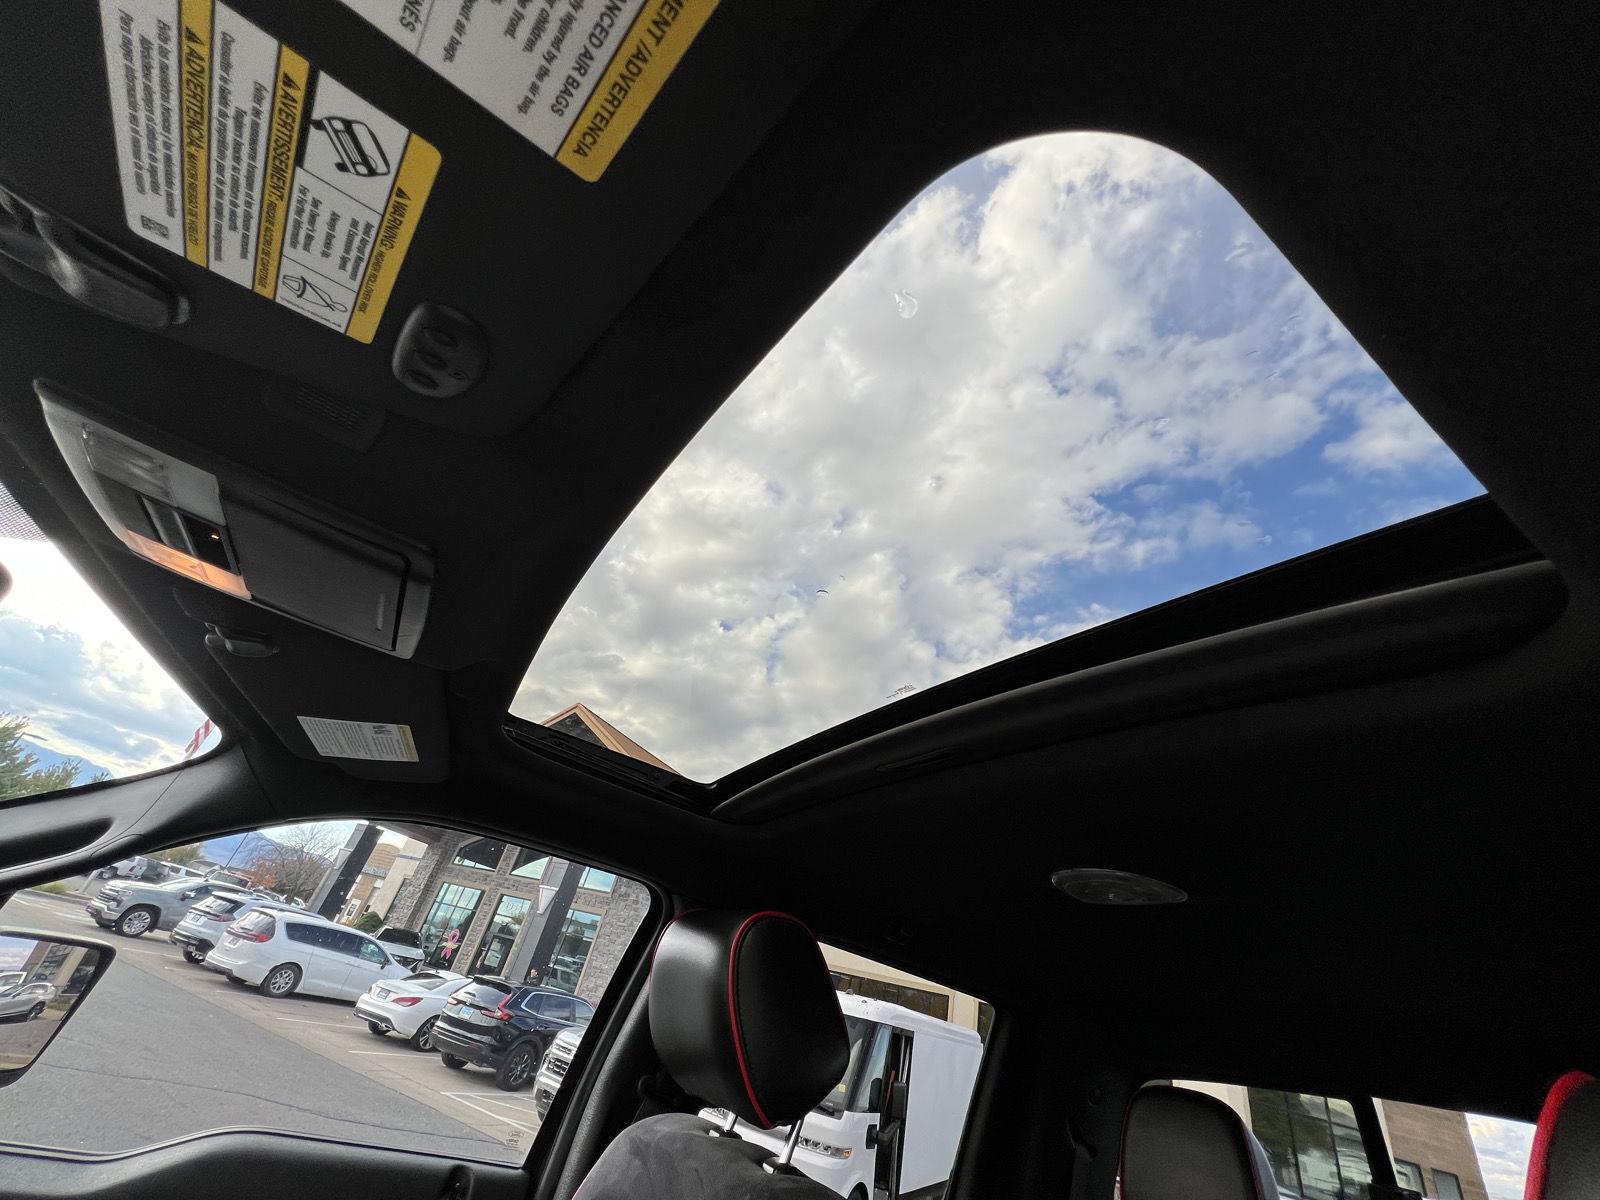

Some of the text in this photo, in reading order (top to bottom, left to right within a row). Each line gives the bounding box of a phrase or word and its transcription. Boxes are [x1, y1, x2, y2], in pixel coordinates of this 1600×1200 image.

[454, 19, 466, 37] air
[551, 12, 576, 53] injured
[543, 49, 558, 65] by
[551, 0, 627, 117] NCED AIR BAGS
[535, 64, 550, 82] the
[529, 81, 540, 97] air
